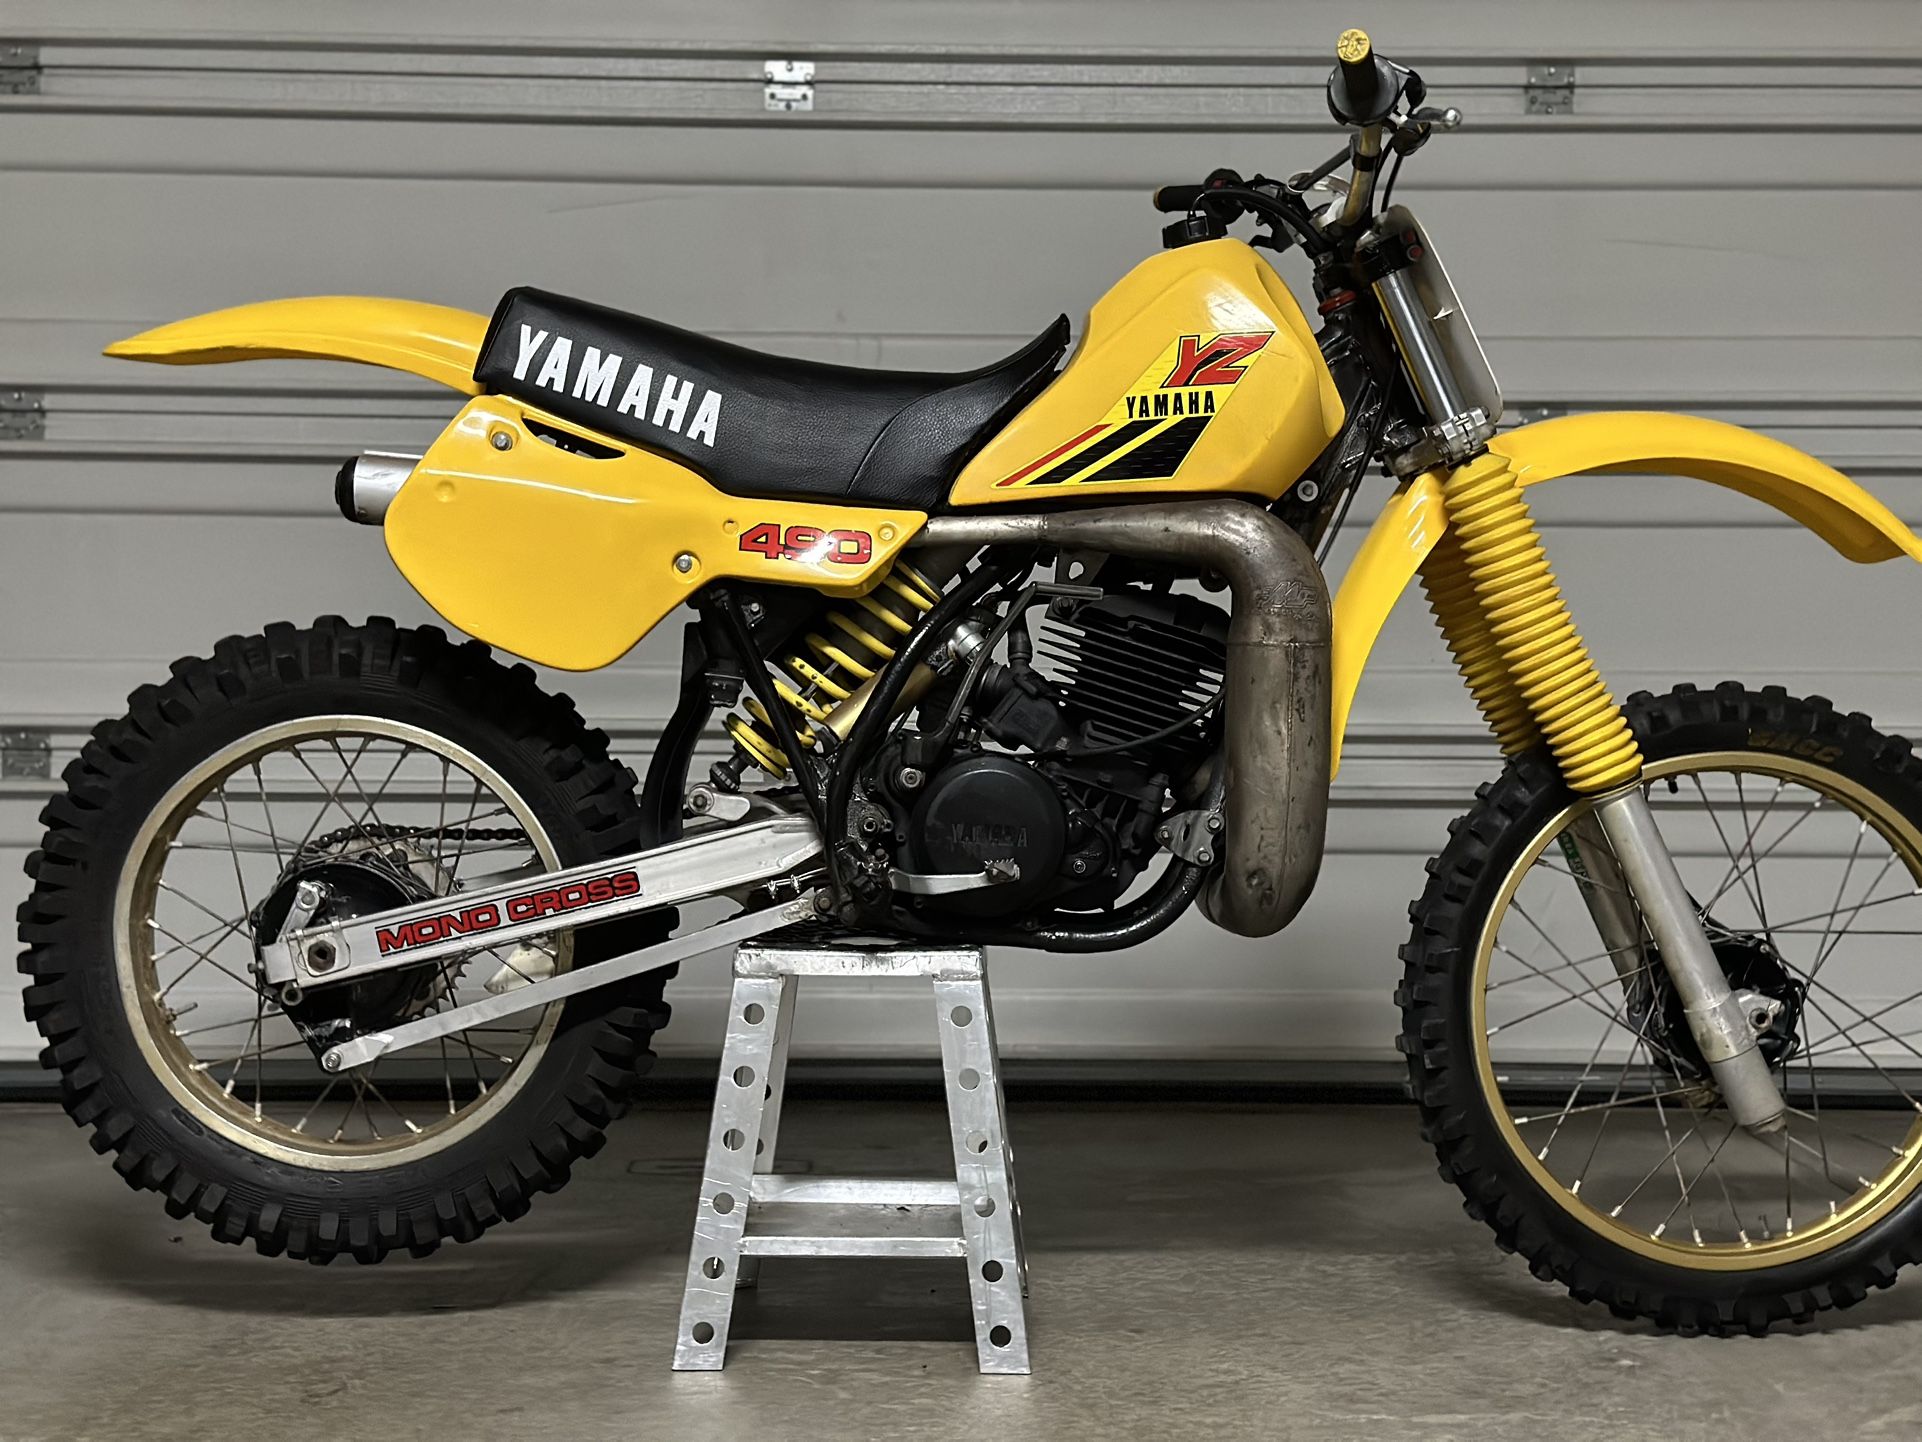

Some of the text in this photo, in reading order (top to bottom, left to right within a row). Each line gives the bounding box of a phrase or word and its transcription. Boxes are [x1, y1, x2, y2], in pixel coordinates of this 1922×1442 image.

[1160, 331, 1276, 388] YZ
[513, 324, 722, 447] YAMAHA
[1126, 391, 1215, 418] YAMAHA
[739, 523, 872, 564] 490
[952, 823, 1028, 848] YMA
[376, 871, 641, 950] MONO CROSS
